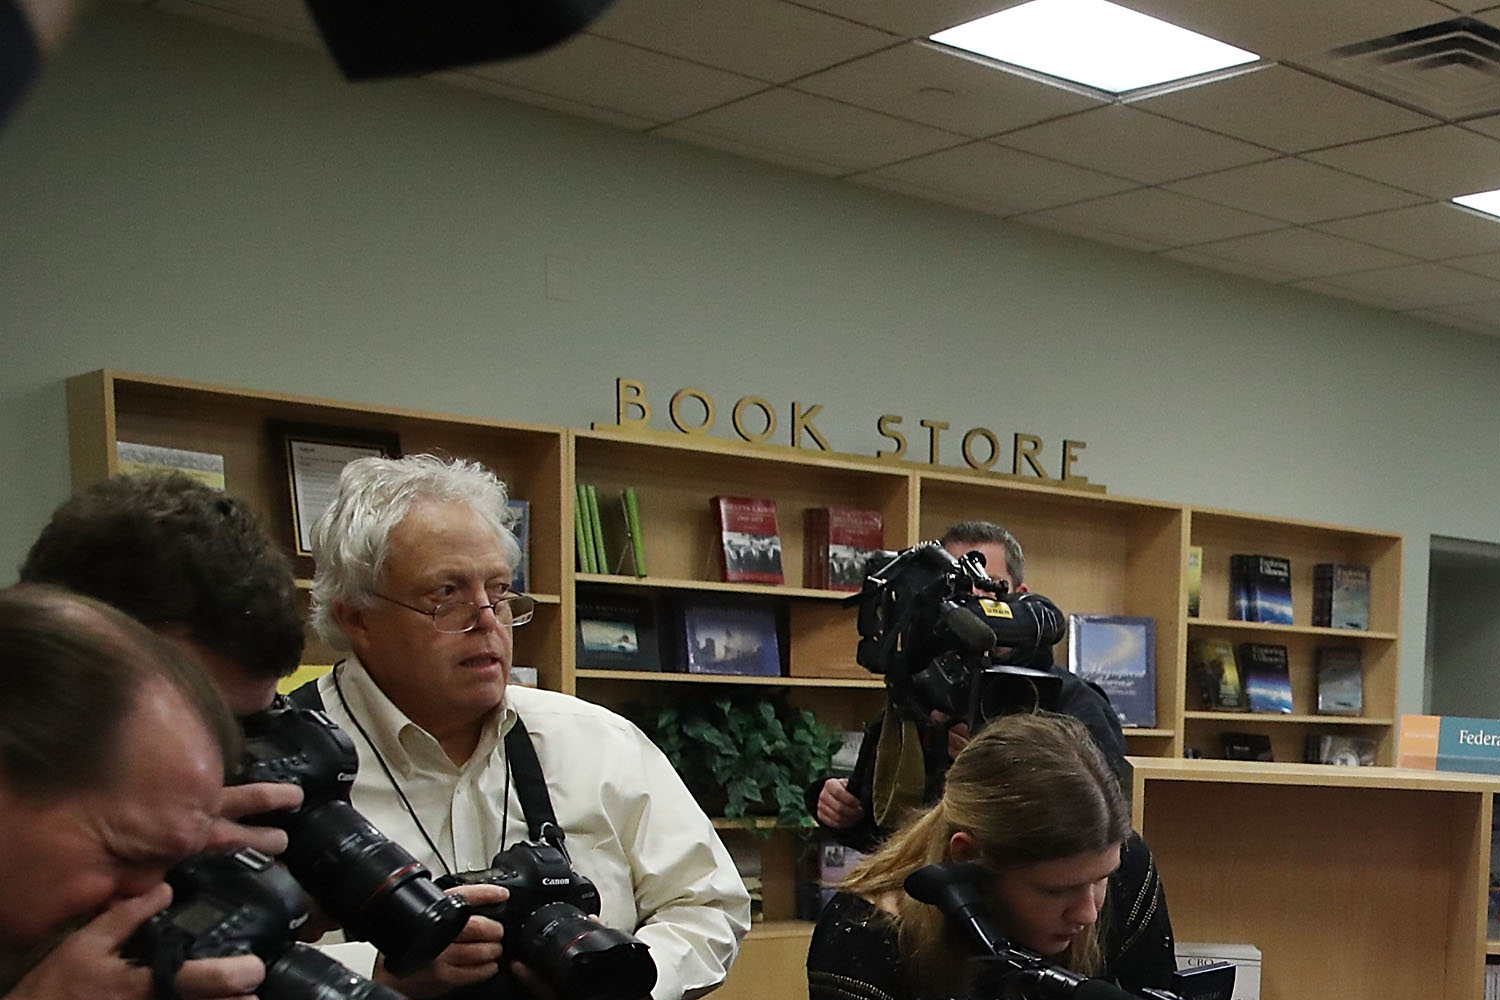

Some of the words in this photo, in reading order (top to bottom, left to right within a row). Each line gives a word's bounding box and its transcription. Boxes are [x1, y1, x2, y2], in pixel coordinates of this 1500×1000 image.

[616, 377, 830, 452] BOOK
[876, 414, 1089, 483] STORE
[542, 877, 570, 886] Canon
